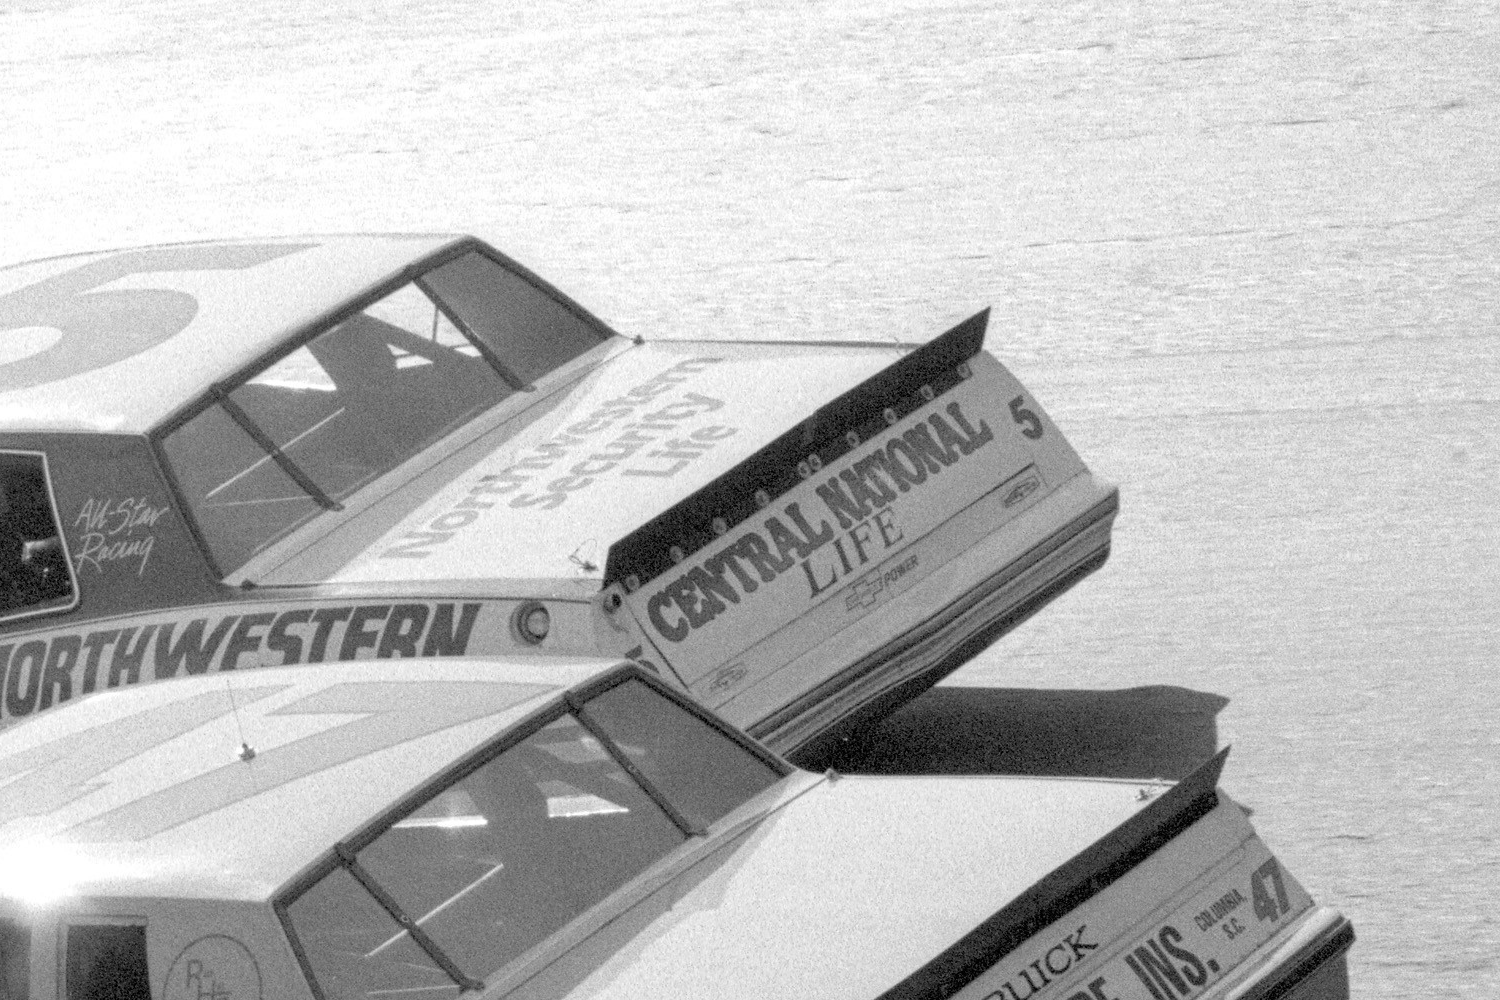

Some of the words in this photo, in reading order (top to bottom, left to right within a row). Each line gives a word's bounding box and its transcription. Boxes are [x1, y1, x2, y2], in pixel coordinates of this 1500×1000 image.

[507, 392, 725, 510] Security
[620, 426, 740, 477] Life
[1008, 395, 1043, 440] 5
[647, 503, 835, 642] CENTRAL
[815, 402, 994, 529] NATIONAL
[800, 506, 906, 599] LIFE
[1251, 855, 1291, 923] 47
